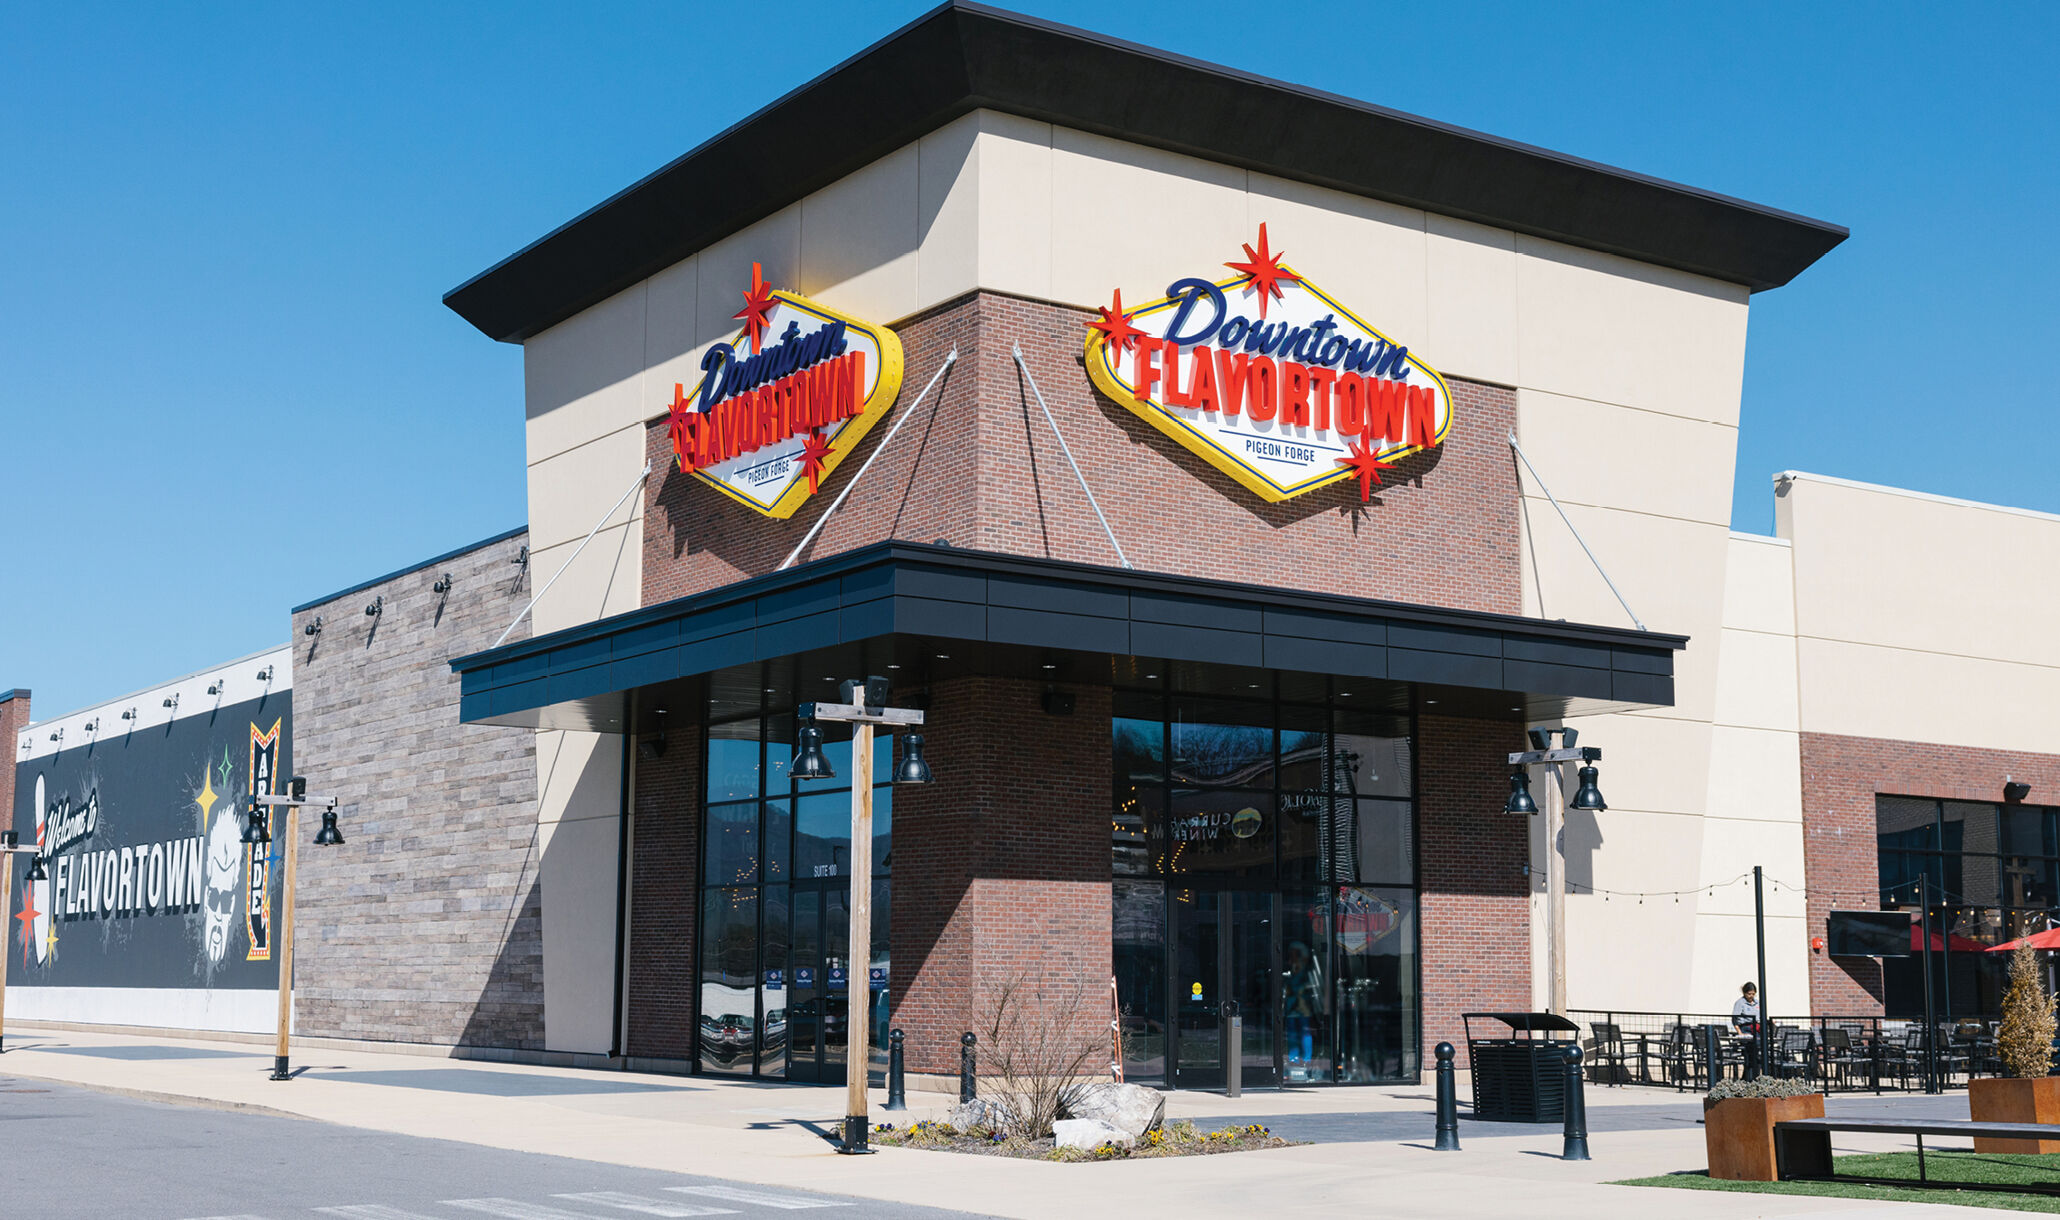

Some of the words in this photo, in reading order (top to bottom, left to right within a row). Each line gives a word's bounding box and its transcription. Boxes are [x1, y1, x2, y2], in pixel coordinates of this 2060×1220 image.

[698, 320, 848, 413] Downtown
[1163, 277, 1411, 380] Downtown
[678, 350, 866, 474] FLAVORTOWN
[1132, 333, 1437, 449] FLAVORTOWN
[747, 464, 770, 484] PIGEON
[770, 459, 790, 477] FORGE
[1245, 439, 1282, 458] PIGEON
[1284, 445, 1316, 463] FORGE
[44, 802, 87, 858] Welcome
[86, 794, 97, 834] to
[251, 752, 268, 916] ARADE
[54, 836, 205, 915] FLAVORTOWN
[813, 864, 828, 878] SUITE
